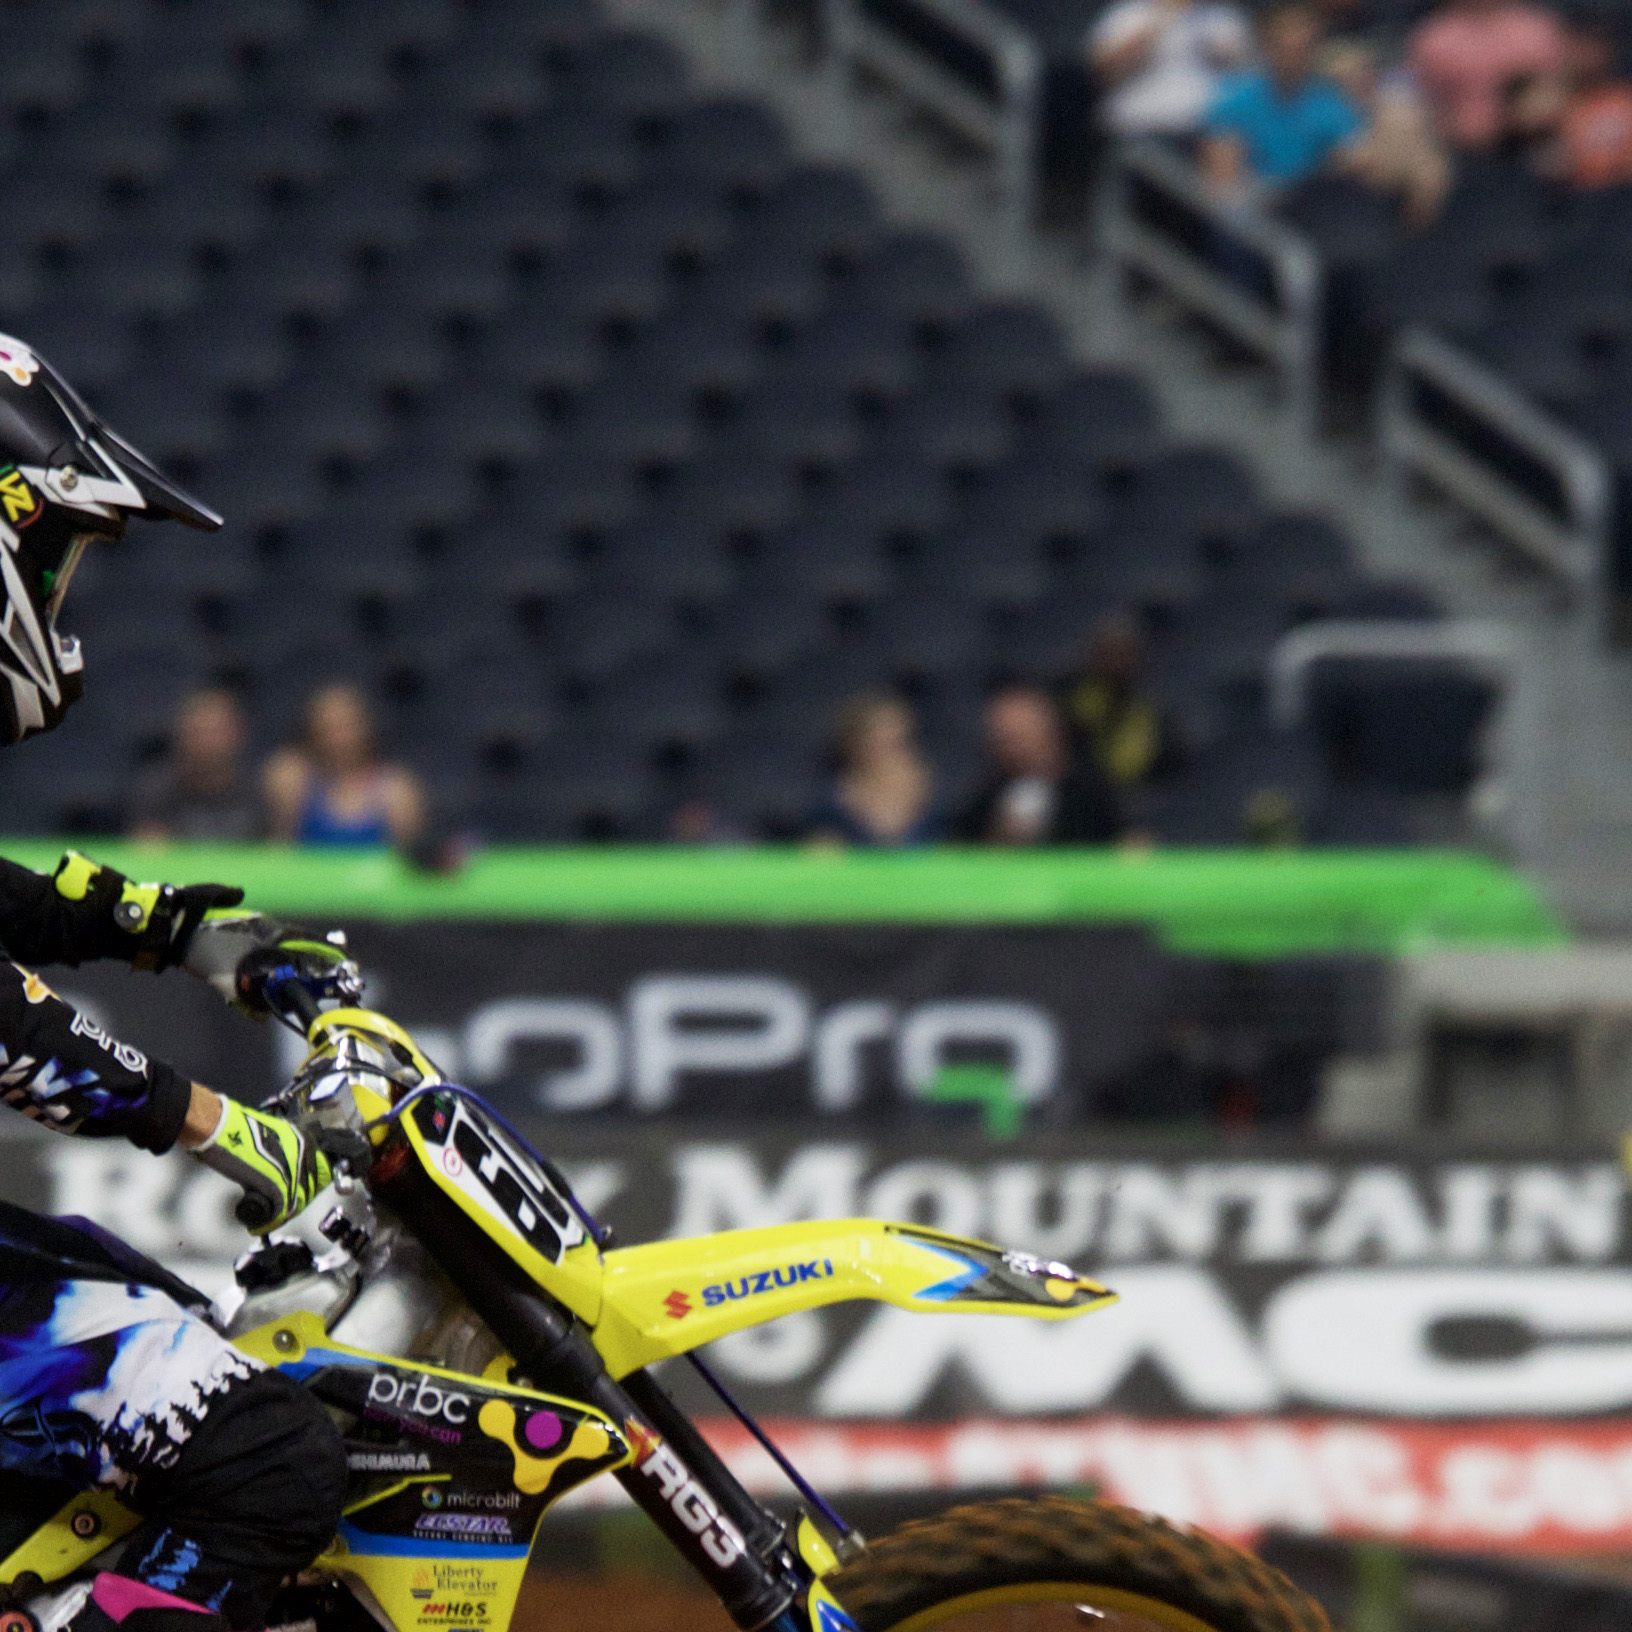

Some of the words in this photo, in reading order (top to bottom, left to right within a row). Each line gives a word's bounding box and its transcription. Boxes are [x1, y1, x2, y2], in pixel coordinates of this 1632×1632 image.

[273, 973, 1062, 1118] oPro
[668, 1145, 1618, 1262] MOUNTAIN
[701, 1257, 835, 1309] SUZUKI
[365, 1373, 470, 1425] prbc
[344, 1451, 432, 1472] SHIMURA
[447, 1492, 521, 1509] microbilt
[640, 1443, 747, 1572] RG3
[433, 1564, 484, 1579] Liberty
[437, 1577, 498, 1592] Elevator
